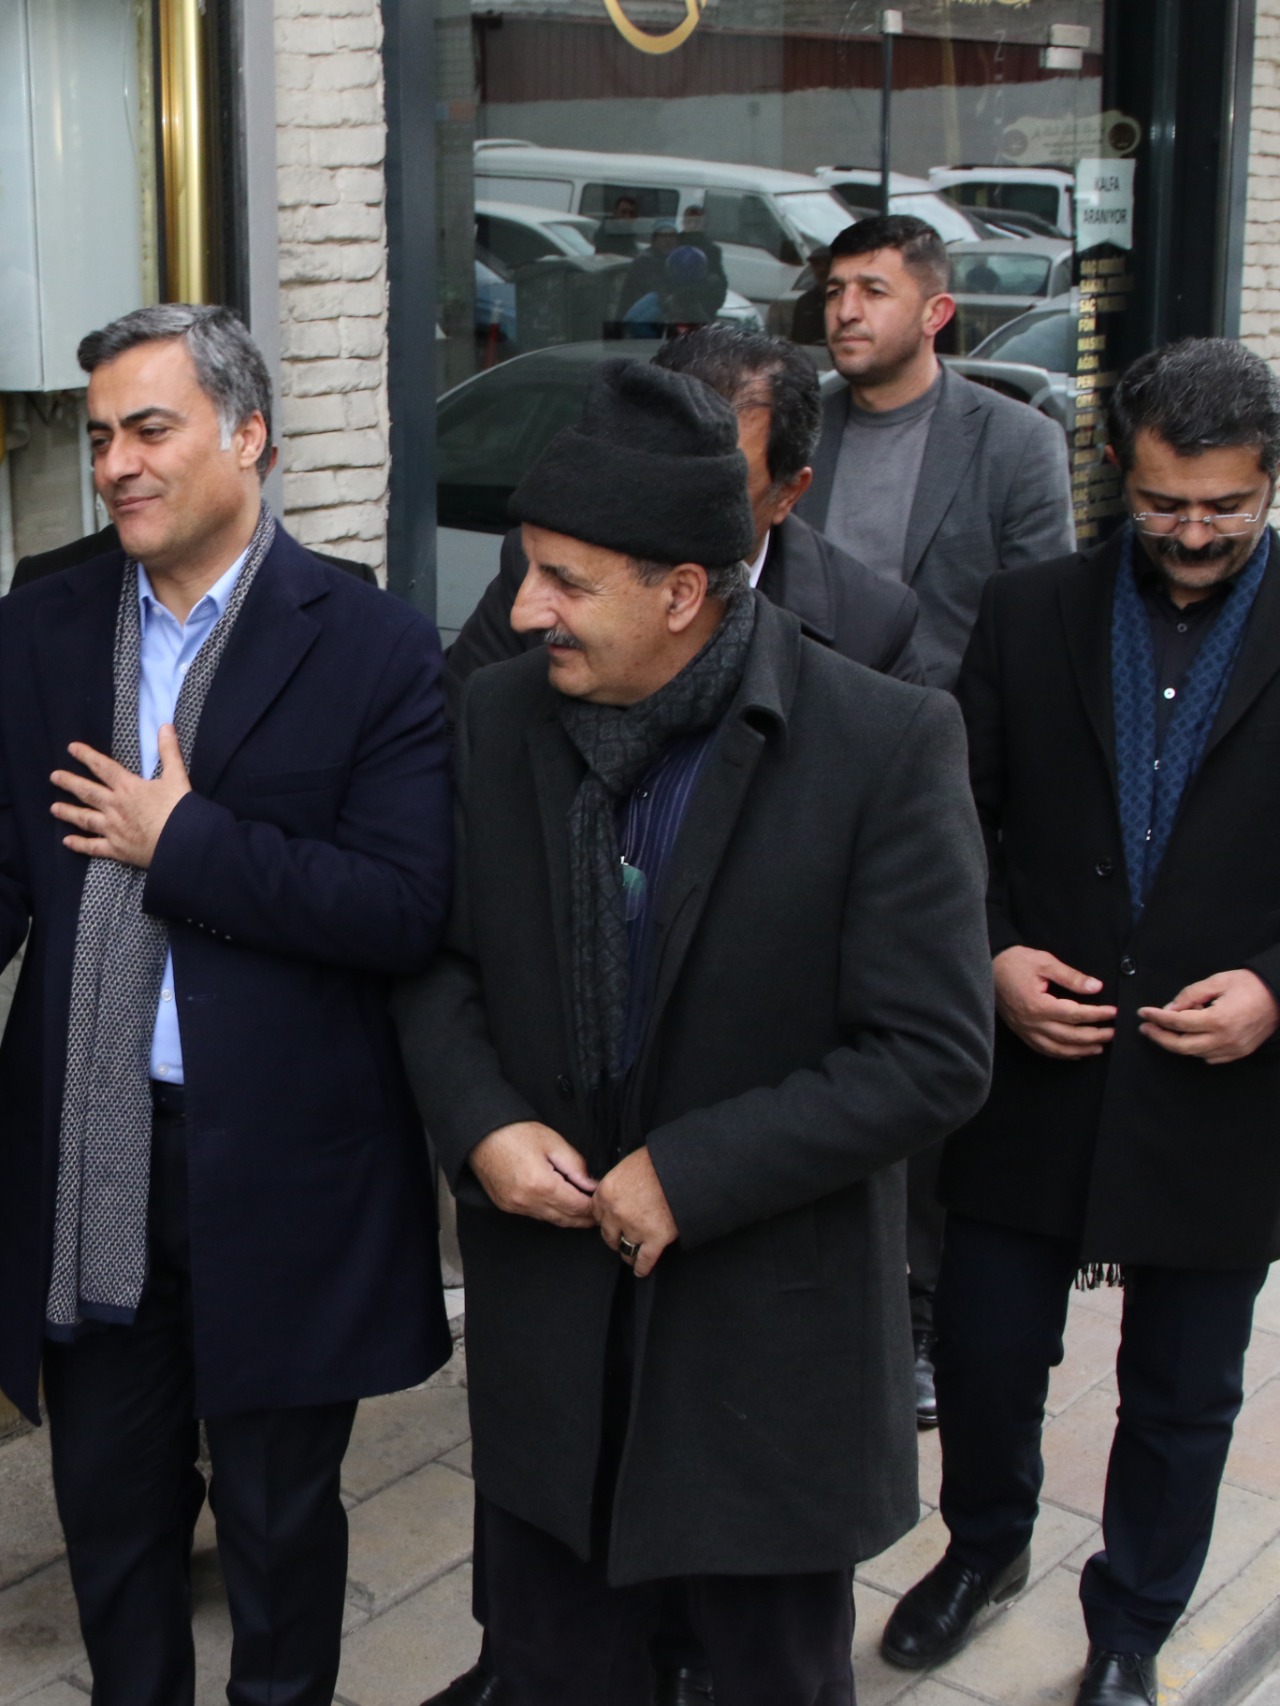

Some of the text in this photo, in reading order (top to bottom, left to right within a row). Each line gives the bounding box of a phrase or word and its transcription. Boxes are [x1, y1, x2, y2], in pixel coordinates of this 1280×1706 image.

[1093, 176, 1121, 192] KALFA
[1083, 208, 1128, 225] ARANIYOR
[1079, 297, 1097, 316] SAÇ
